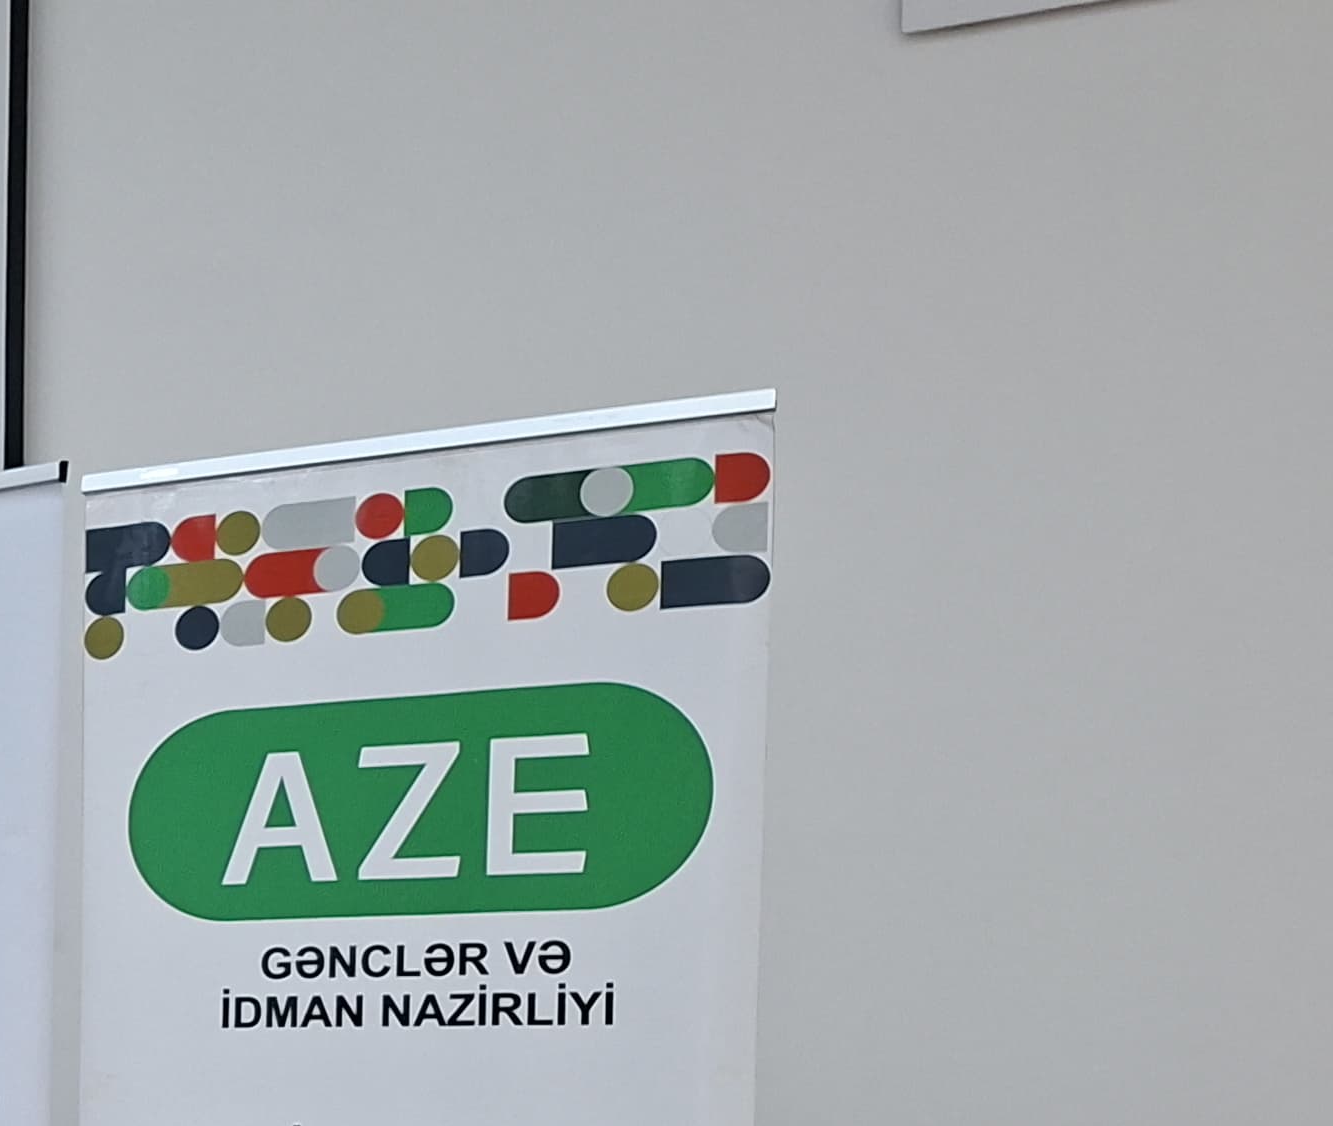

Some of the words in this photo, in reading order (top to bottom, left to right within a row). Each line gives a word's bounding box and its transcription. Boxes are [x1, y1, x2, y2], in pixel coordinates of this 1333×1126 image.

[221, 732, 589, 885] AZE
[261, 942, 489, 980] GƏNCLƏR
[503, 939, 571, 975] VƏ
[221, 988, 363, 1028] İDMAN
[381, 982, 614, 1027] NAZİRLİYİ
